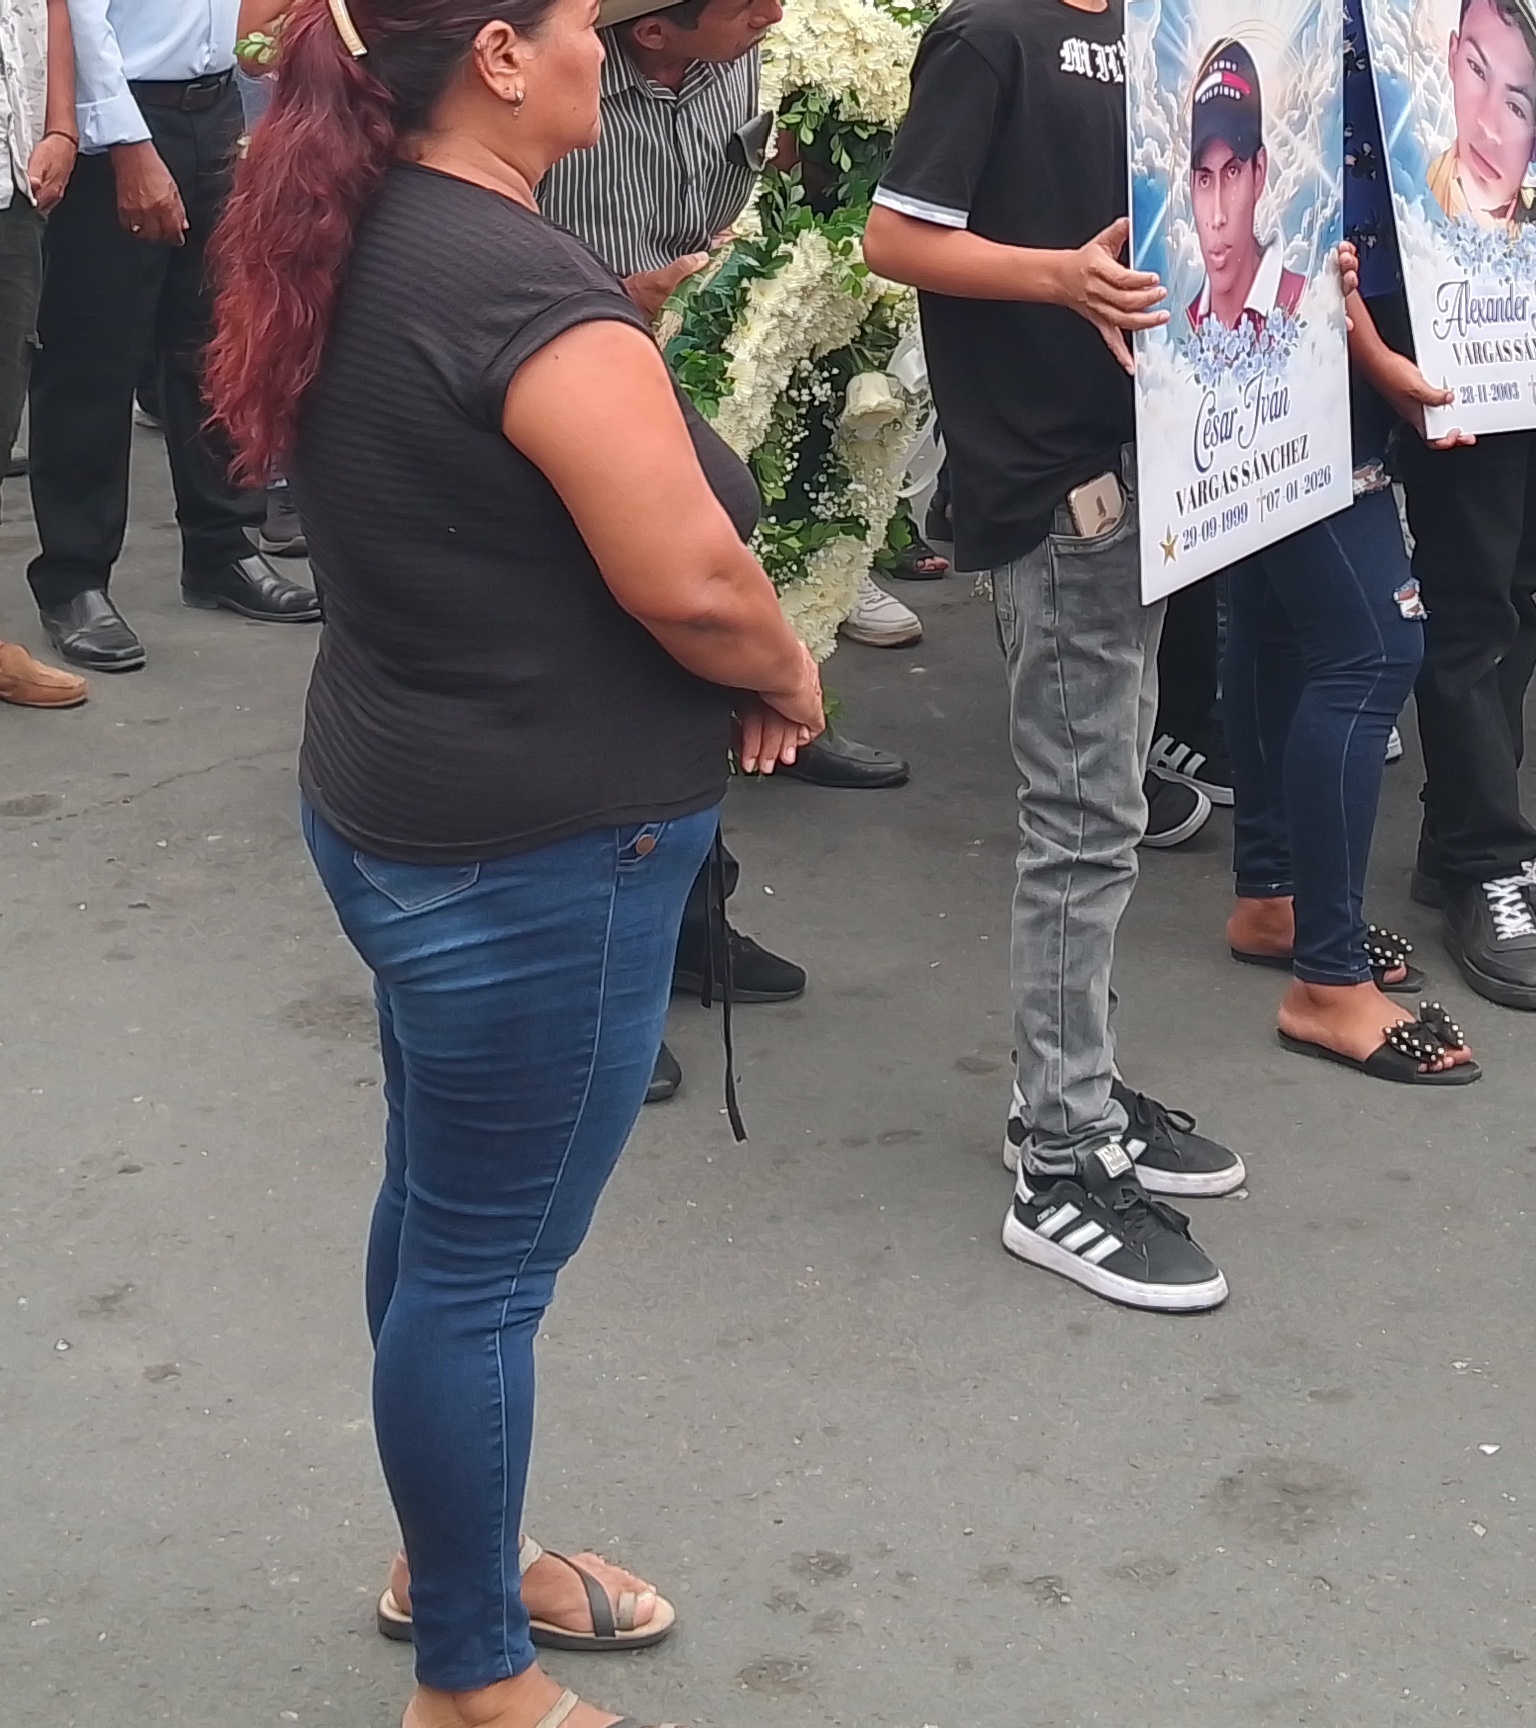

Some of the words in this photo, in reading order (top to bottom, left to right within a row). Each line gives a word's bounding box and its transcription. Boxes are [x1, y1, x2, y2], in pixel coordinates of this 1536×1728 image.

[1433, 278, 1530, 340] Alexander
[1452, 338, 1514, 366] VARGAS
[1194, 388, 1239, 474] César
[1238, 368, 1292, 450] Iván
[1175, 472, 1241, 517] VARGAS
[1240, 433, 1311, 487] SÁNCHEZ
[1181, 501, 1249, 552] 29-09-1999
